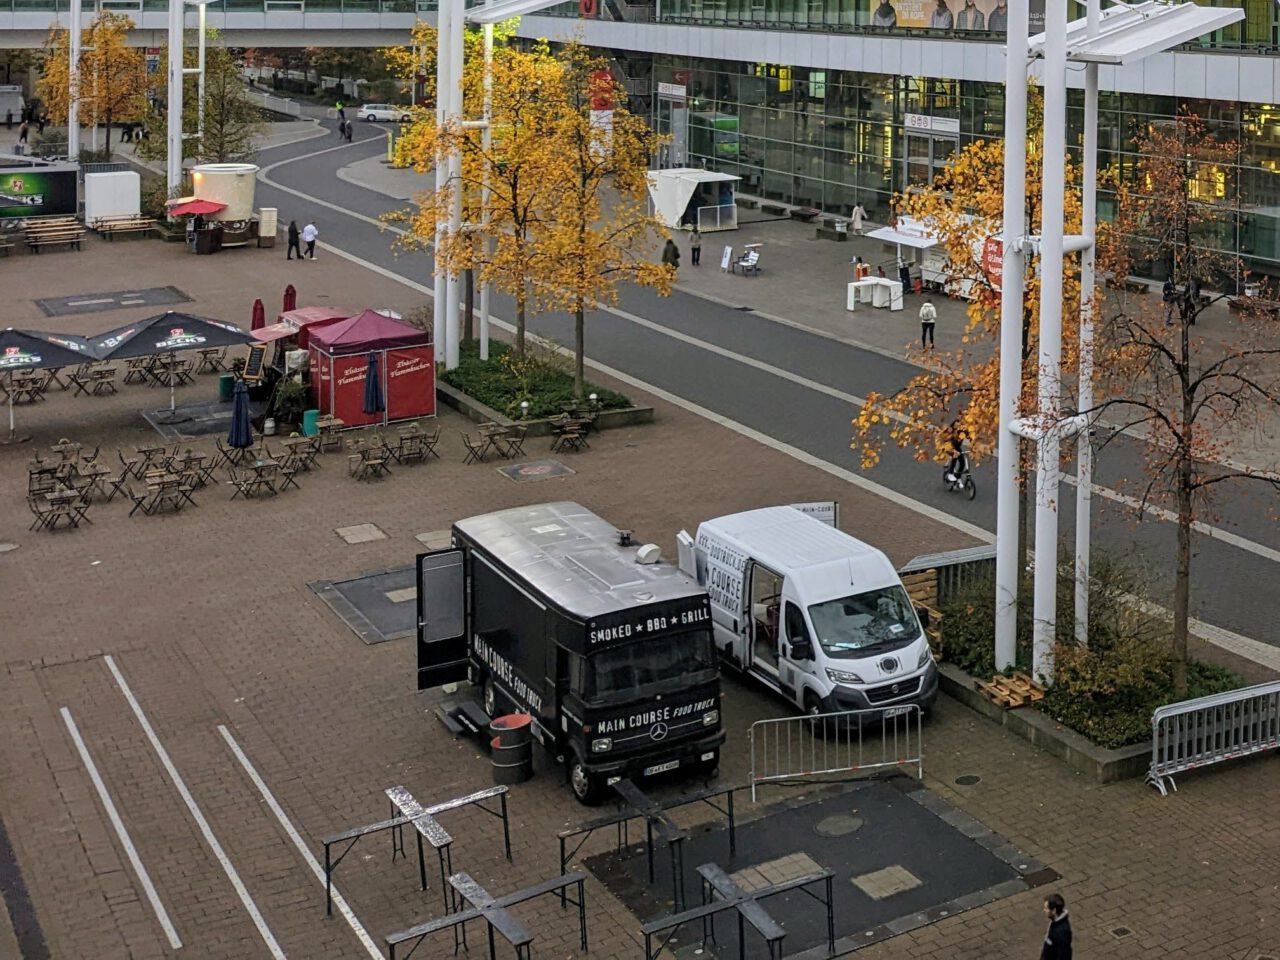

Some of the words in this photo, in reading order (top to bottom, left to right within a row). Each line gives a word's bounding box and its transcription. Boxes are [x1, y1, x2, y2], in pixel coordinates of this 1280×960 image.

[0, 355, 42, 366] ECK'S
[711, 567, 742, 600] COURSE
[591, 625, 632, 643] SMOKED
[646, 617, 667, 632] BBQ
[681, 607, 709, 624] GRILL
[475, 633, 488, 663] MAIN
[489, 647, 513, 687] COURSE
[514, 676, 527, 698] FOOD
[527, 688, 542, 712] TRUCK
[598, 718, 626, 734] MAIN
[629, 707, 670, 728] COURSE
[673, 703, 693, 717] FOOD
[693, 698, 715, 711] TRUCK
